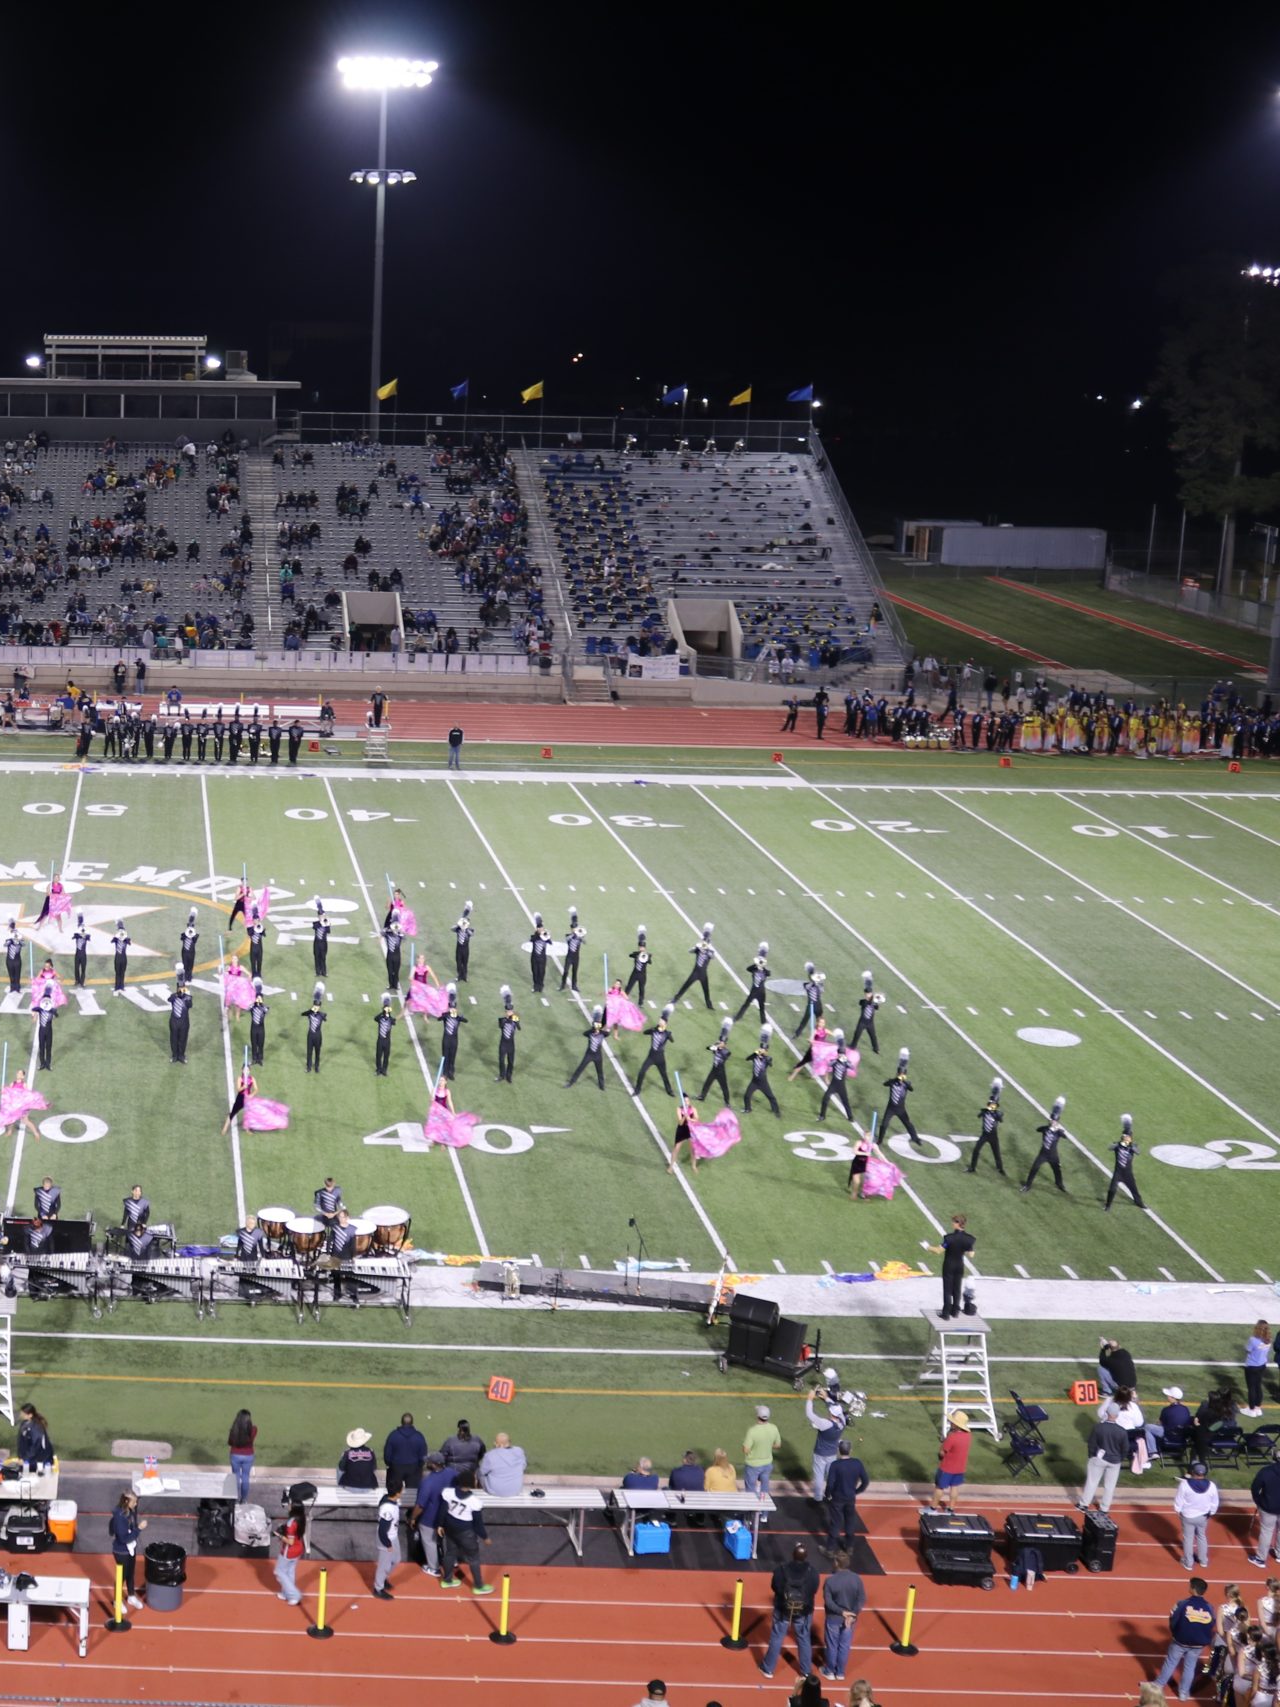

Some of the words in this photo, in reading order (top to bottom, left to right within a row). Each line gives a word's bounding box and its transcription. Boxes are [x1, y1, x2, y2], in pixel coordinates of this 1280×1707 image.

[22, 802, 129, 817] 50
[284, 807, 392, 822] 40
[547, 813, 658, 828] 30
[810, 818, 922, 833] 20
[363, 1121, 535, 1155] 40
[783, 1130, 963, 1164] 30
[490, 1379, 510, 1400] 40
[1078, 1383, 1096, 1402] 30
[450, 1499, 468, 1516] 77
